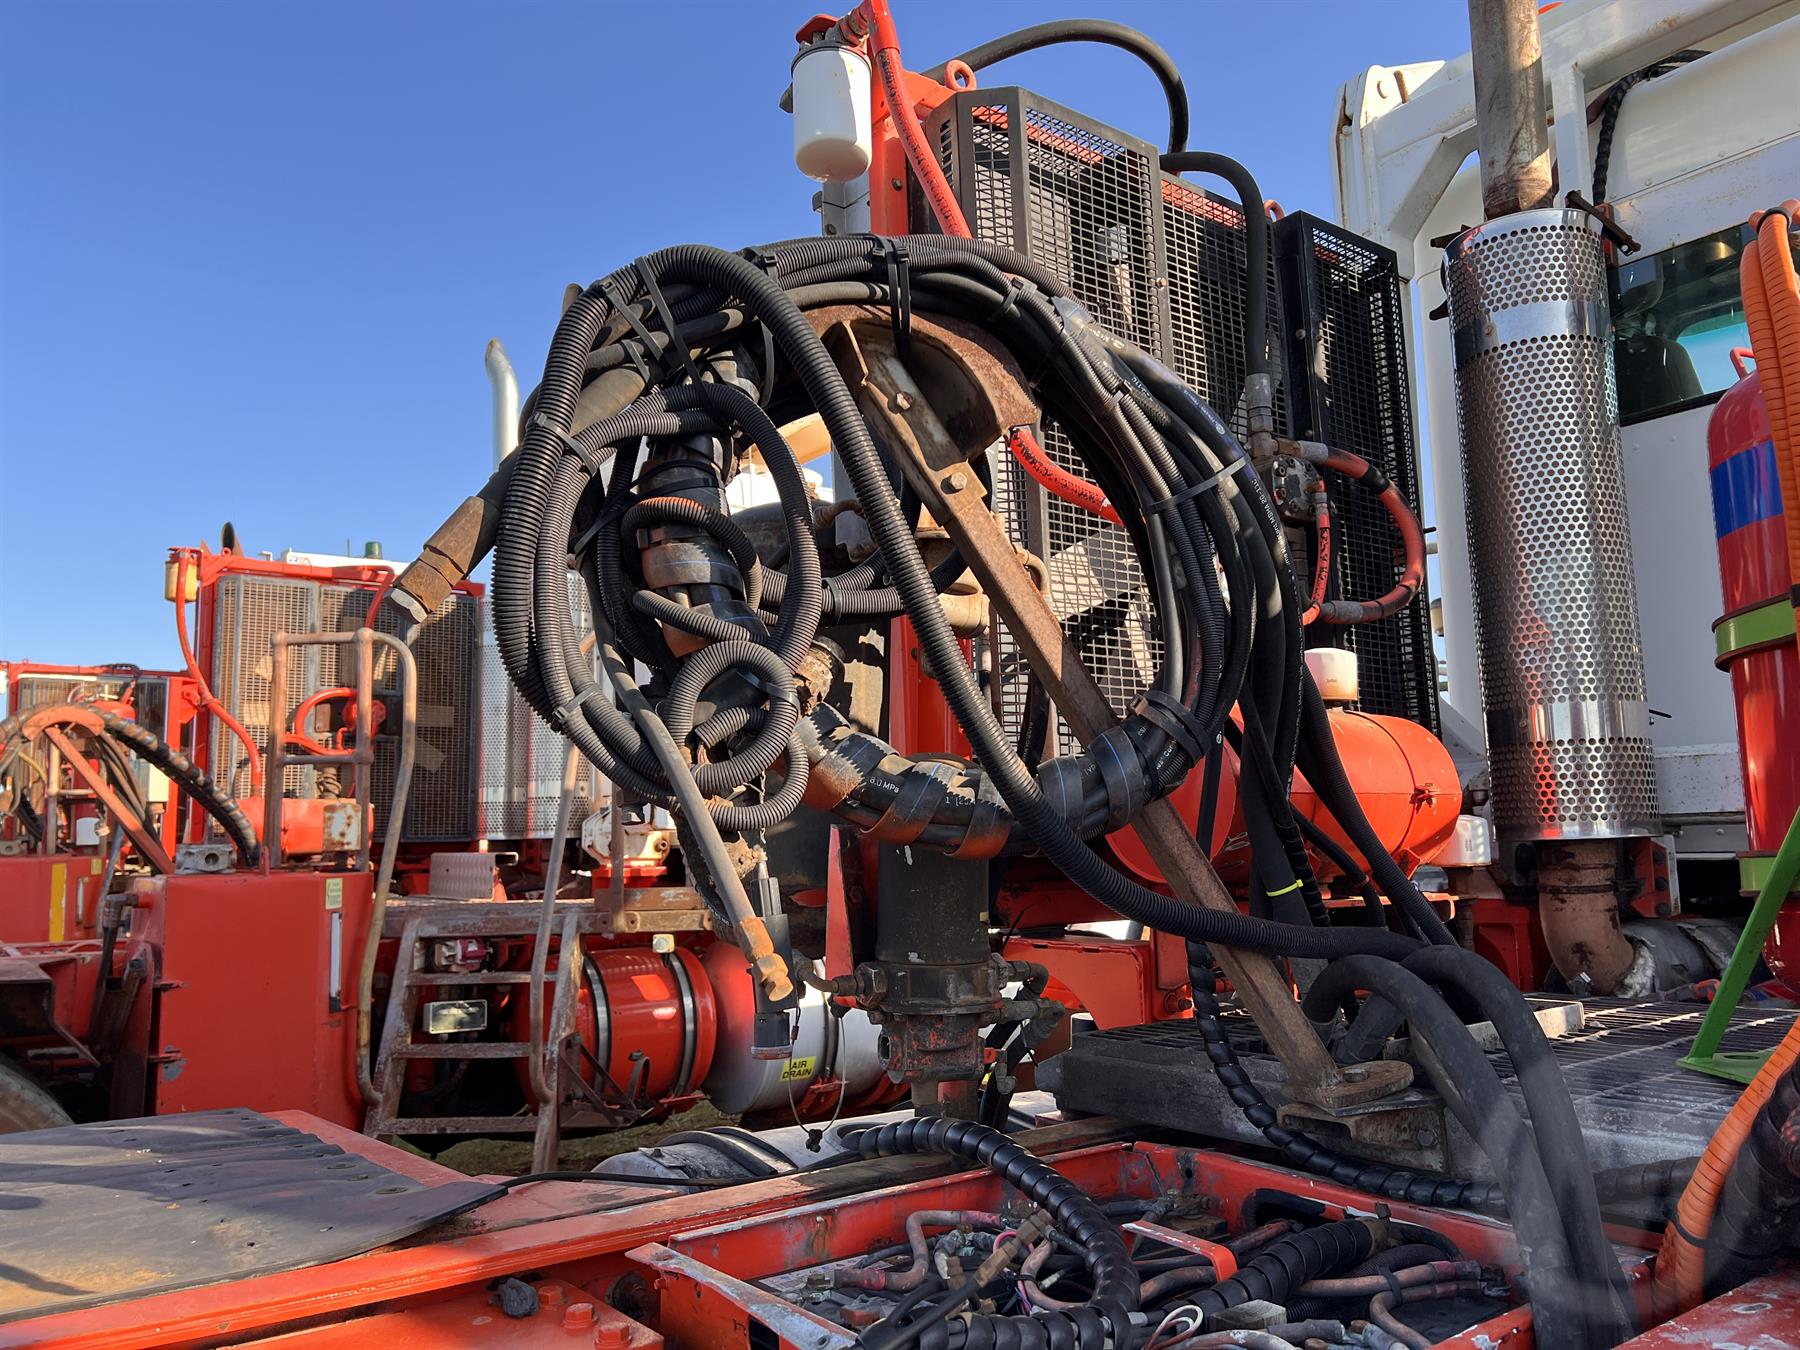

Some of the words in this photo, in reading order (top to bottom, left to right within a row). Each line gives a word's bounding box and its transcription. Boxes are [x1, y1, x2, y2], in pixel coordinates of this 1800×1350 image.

[882, 781, 900, 793] MPa
[791, 1060, 807, 1069] AIR
[782, 1068, 812, 1079] DRAIN
